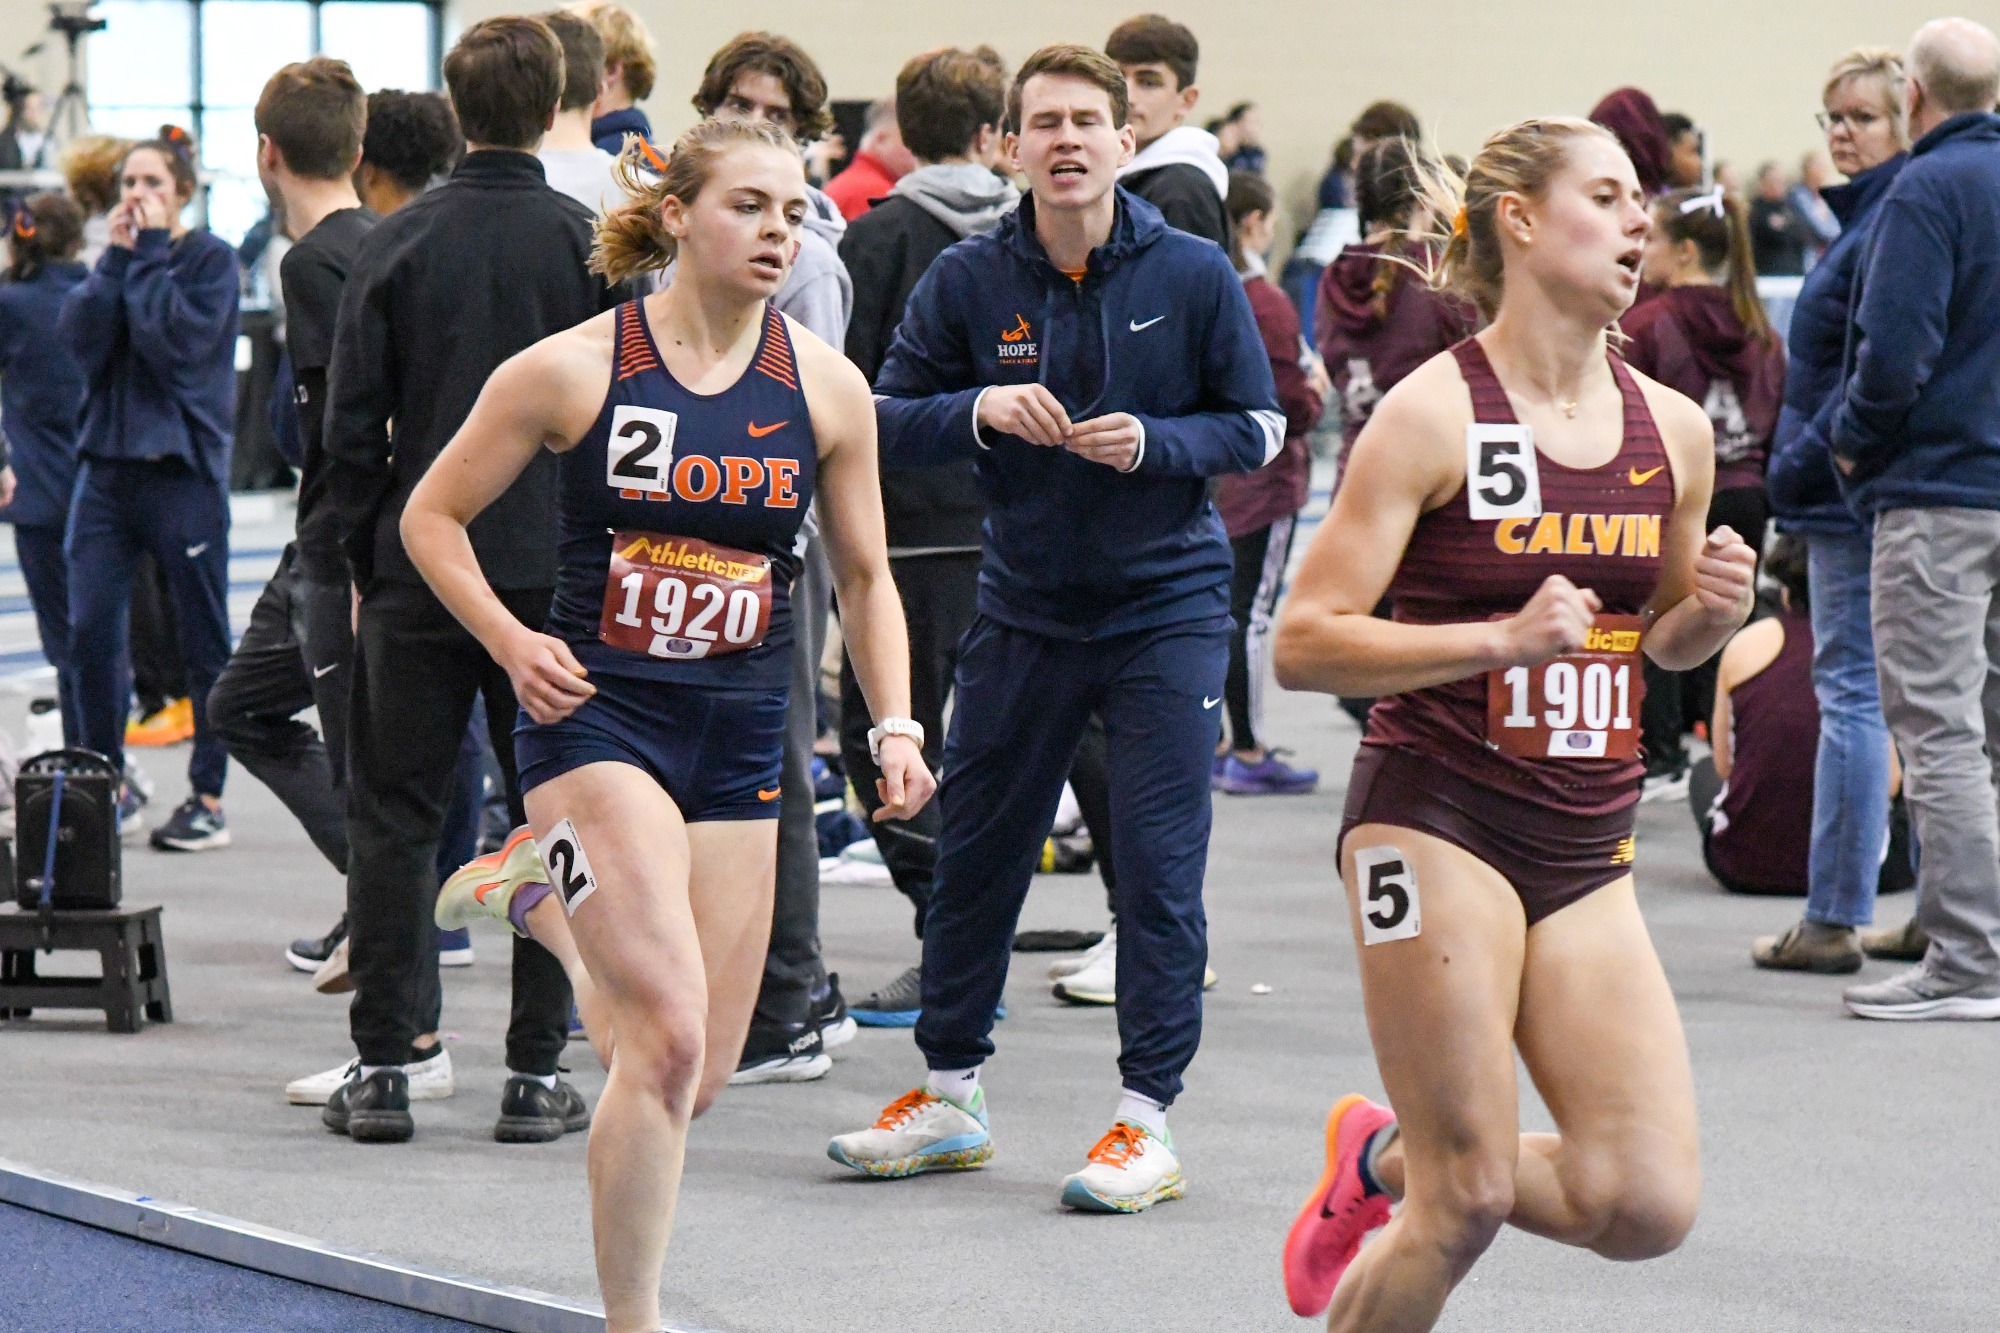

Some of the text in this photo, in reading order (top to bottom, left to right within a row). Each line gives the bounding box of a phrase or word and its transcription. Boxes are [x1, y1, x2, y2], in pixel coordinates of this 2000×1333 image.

[997, 343, 1037, 356] HOPE
[612, 419, 662, 480] 2
[619, 454, 800, 509] OPE
[1478, 441, 1527, 506] 5
[1494, 512, 1662, 557] CALVIN
[615, 572, 761, 644] 1920
[1503, 662, 1632, 730] 1901
[549, 838, 588, 905] 2
[1368, 860, 1410, 929] 5
